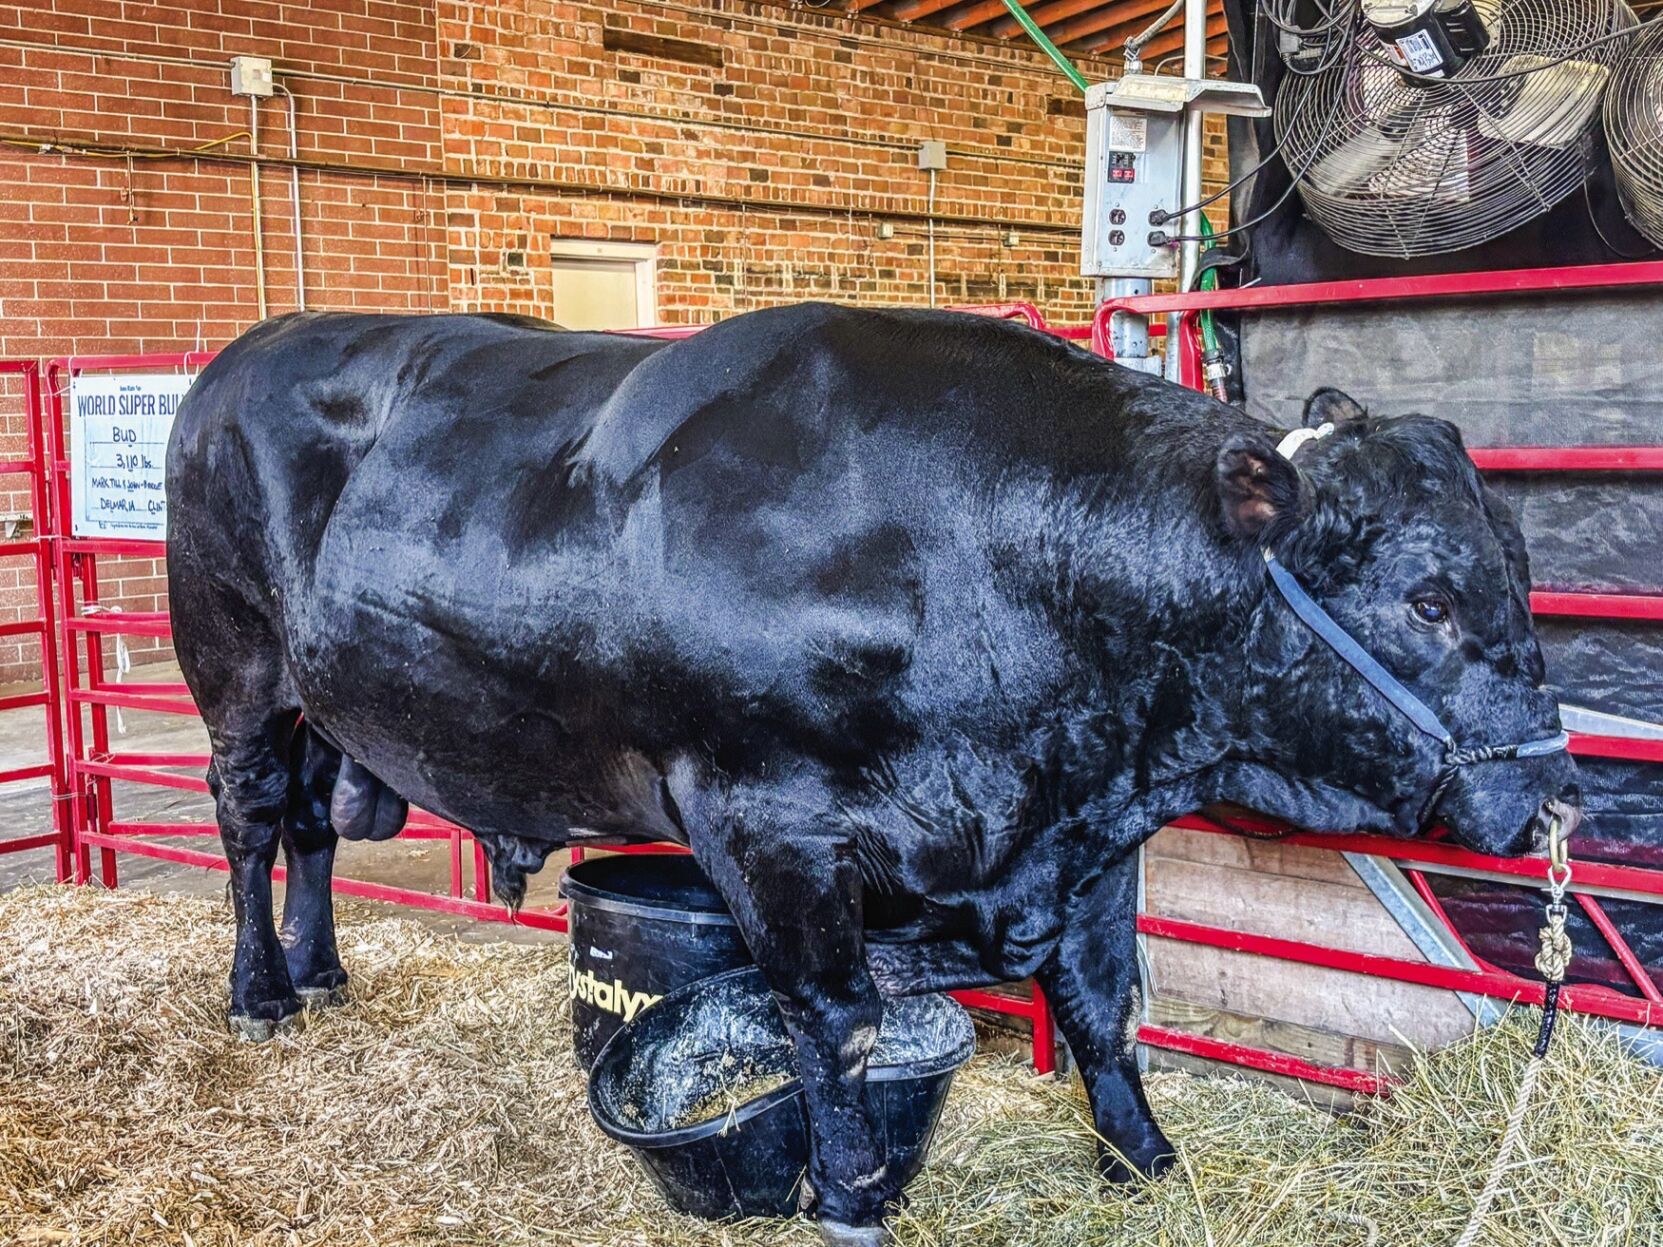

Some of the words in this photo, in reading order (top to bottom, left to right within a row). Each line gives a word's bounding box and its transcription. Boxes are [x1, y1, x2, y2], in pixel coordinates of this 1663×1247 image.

[77, 394, 116, 417] WORLD
[118, 394, 156, 416] SUPER
[112, 426, 138, 443] BUD
[115, 453, 139, 469] 3,110
[568, 964, 664, 1023] ystalyx
